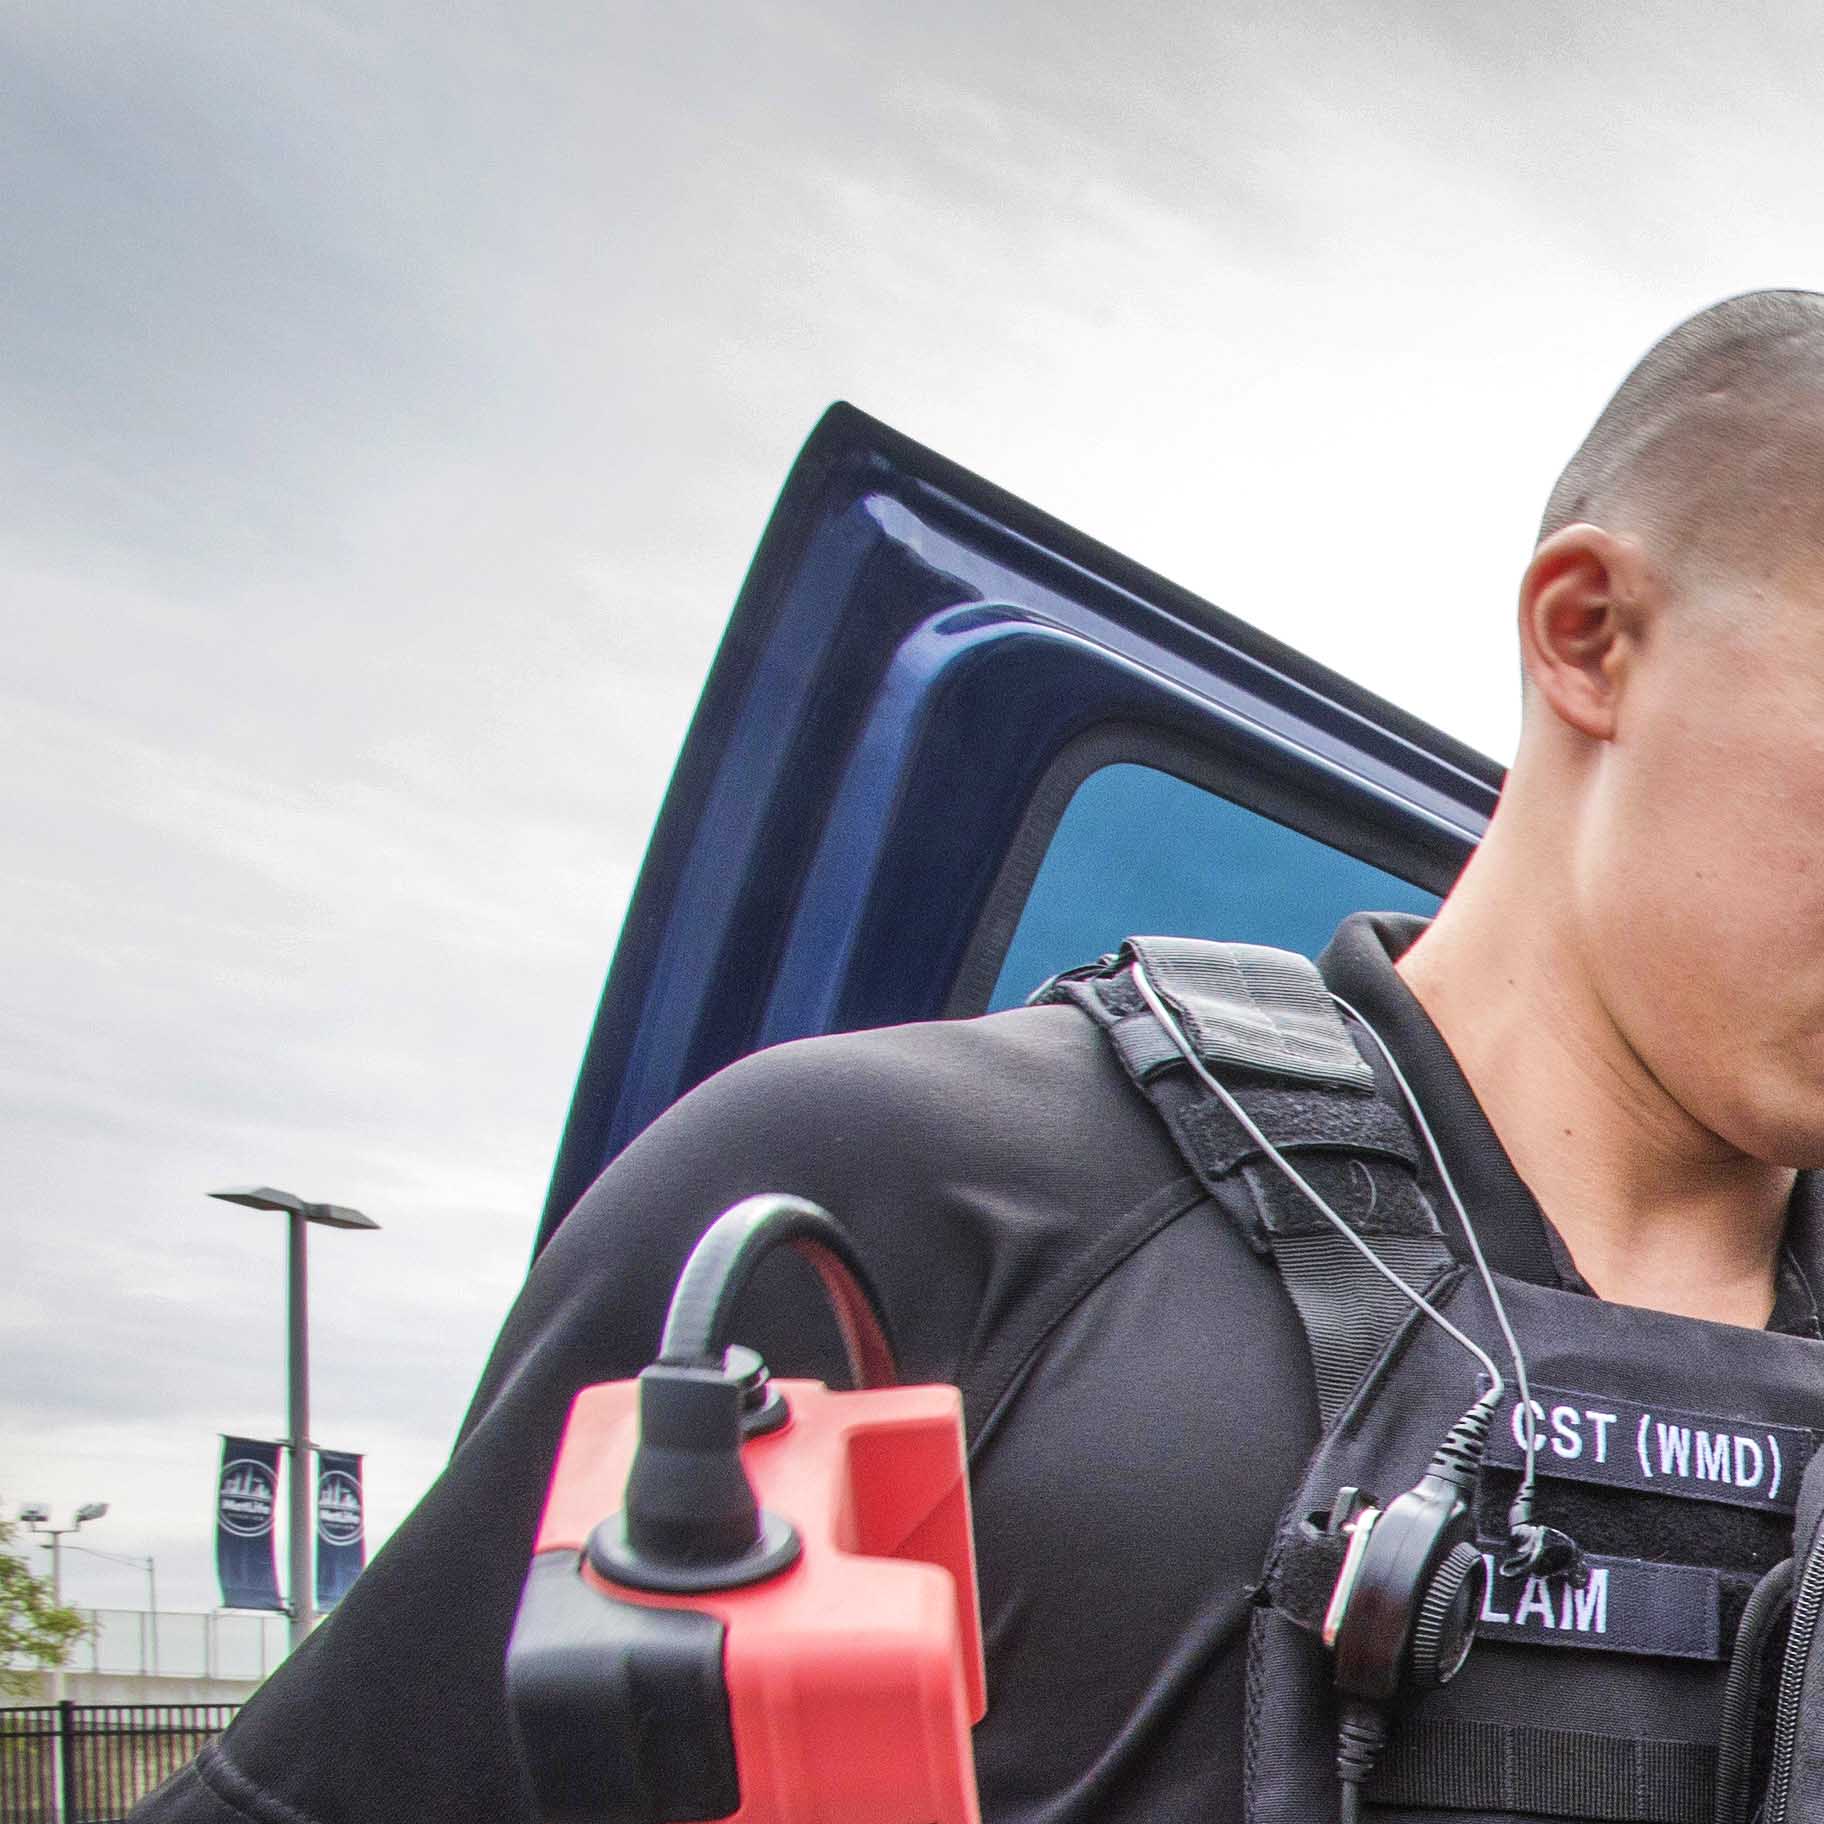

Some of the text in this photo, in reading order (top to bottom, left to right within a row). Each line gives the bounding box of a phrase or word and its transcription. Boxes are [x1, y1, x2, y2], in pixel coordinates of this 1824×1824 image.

[1510, 1399, 1782, 1499] CST (WMD)
[1480, 1554, 1609, 1633] LAM
